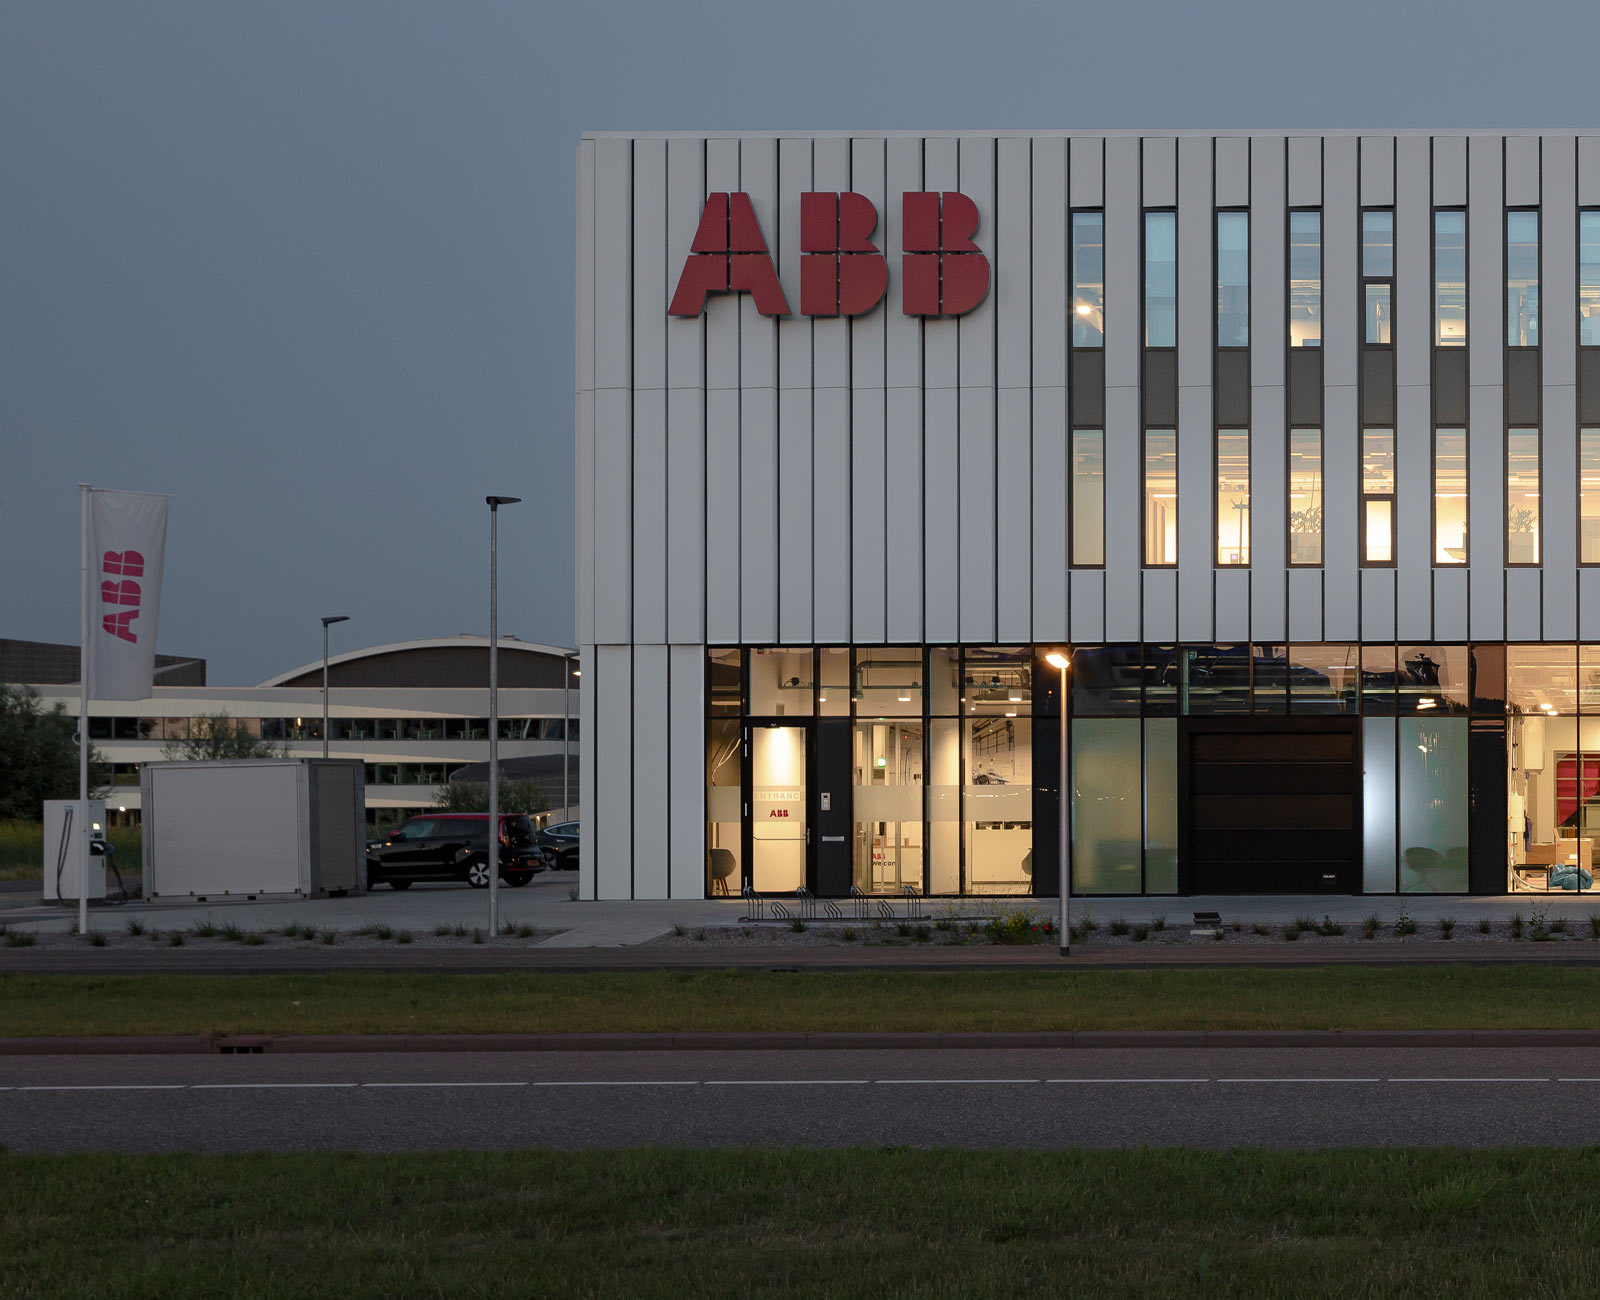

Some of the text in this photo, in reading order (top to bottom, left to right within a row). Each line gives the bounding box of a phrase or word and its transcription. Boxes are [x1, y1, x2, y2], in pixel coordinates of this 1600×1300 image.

[668, 192, 991, 316] ABB
[101, 550, 145, 644] ABB
[769, 809, 789, 817] ABB
